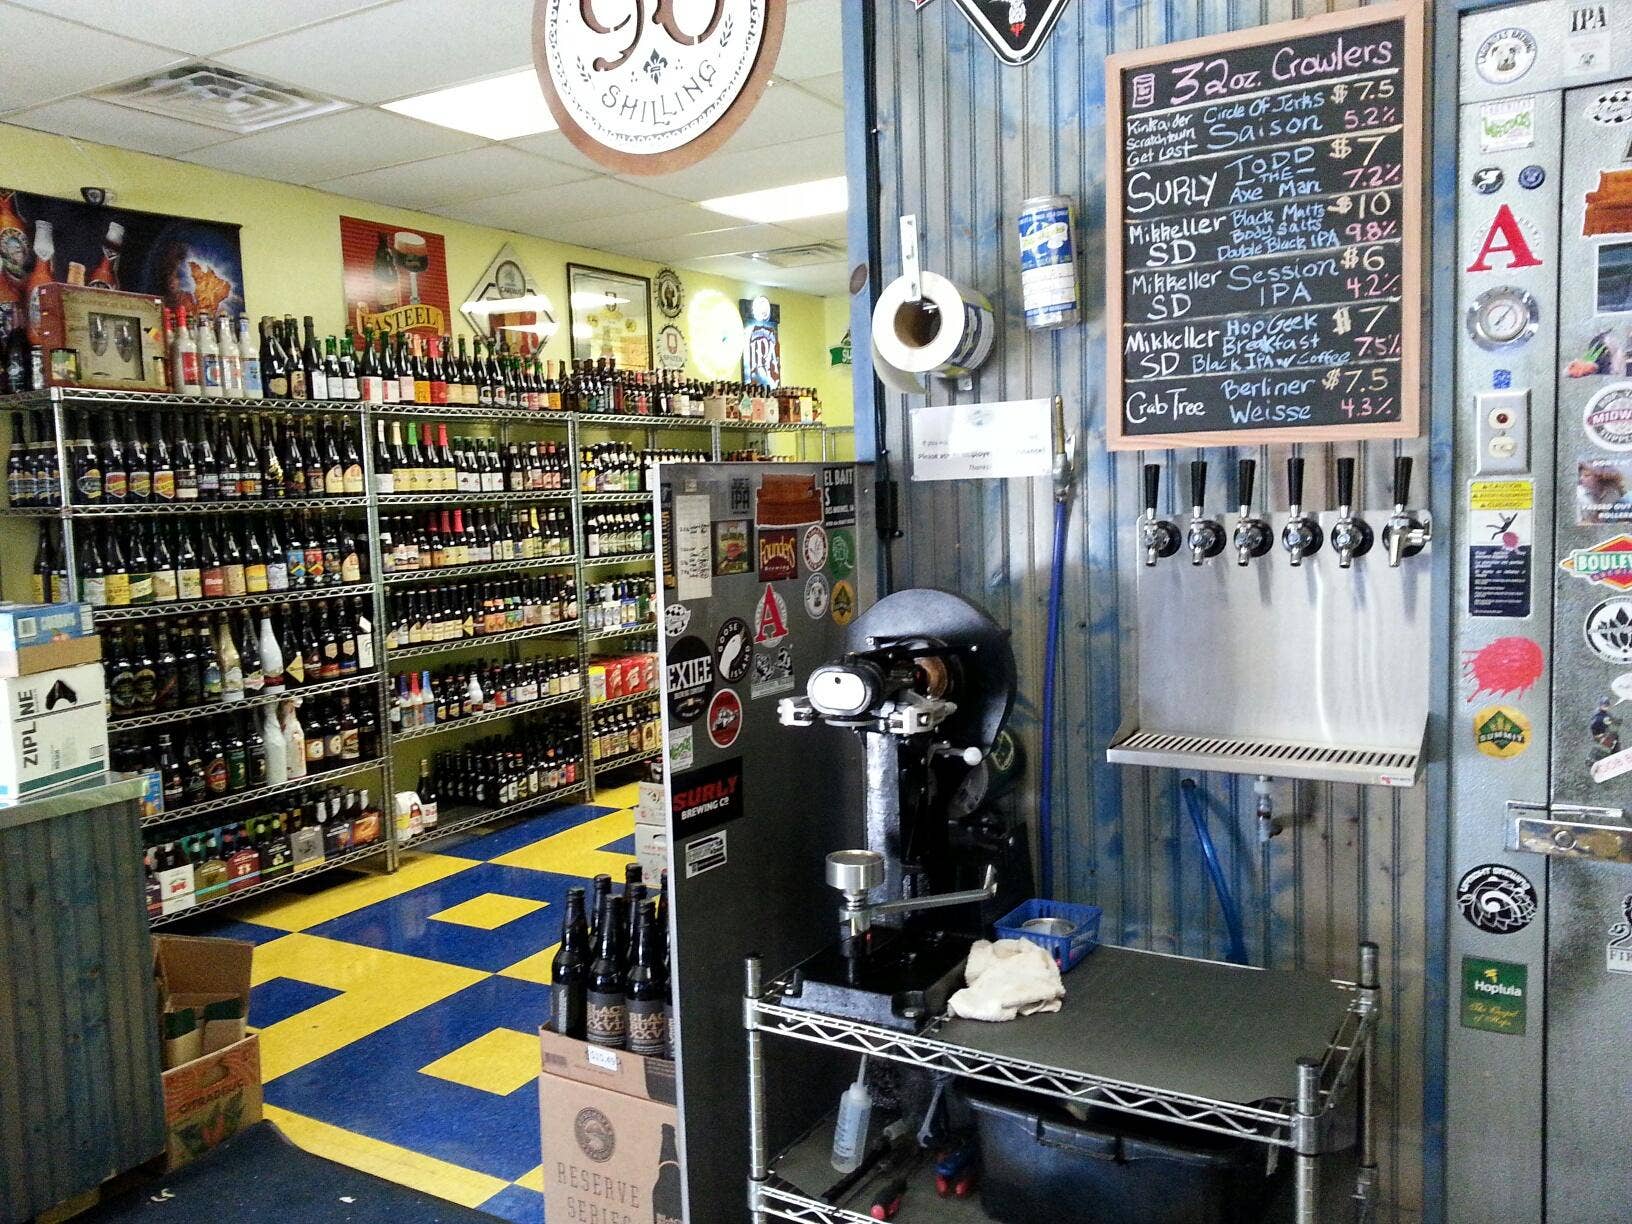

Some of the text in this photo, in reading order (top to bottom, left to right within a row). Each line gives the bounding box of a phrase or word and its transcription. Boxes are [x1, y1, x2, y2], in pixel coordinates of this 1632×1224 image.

[1571, 6, 1607, 32] IPA
[601, 58, 717, 126] SHILLING
[1203, 104, 1246, 123] Circle
[1270, 91, 1325, 112] Jerks
[1345, 106, 1396, 129] 5.2%
[1207, 115, 1323, 150] Saison
[1126, 140, 1199, 167] Get Lost
[1259, 166, 1294, 183] THE
[1342, 163, 1402, 189] 7.2%
[1126, 171, 1218, 213] SURLY
[1228, 179, 1323, 205] Axe Man
[1129, 216, 1227, 245] Mikkeller
[1230, 207, 1275, 229] Black
[1217, 241, 1264, 262] Double
[1310, 228, 1341, 250] IPA
[1229, 224, 1273, 245] Body
[1465, 203, 1543, 273] A
[1146, 239, 1197, 267] SD
[1131, 270, 1222, 296] Mikkeller
[1226, 257, 1340, 291] Session
[1346, 272, 1401, 299] 4.2%
[1147, 292, 1192, 320] SD
[1260, 280, 1312, 307] IPA
[361, 306, 437, 336] KASTEEL
[1226, 318, 1265, 340] Hop
[1123, 325, 1221, 356] Mikkeller
[1222, 332, 1321, 358] Breakfast
[1140, 352, 1181, 379] SD
[1191, 353, 1242, 373] Black
[1244, 351, 1275, 371] IPA
[1297, 349, 1350, 366] Coffee
[1220, 376, 1317, 401] Berliner
[1126, 387, 1207, 424] Crab Tree
[1229, 400, 1312, 424] Weisse
[1340, 397, 1394, 419] 4.3%
[824, 470, 833, 486] EL
[760, 535, 795, 569] Founders
[754, 582, 789, 644] A
[717, 622, 739, 653] GOOSE
[667, 655, 713, 694] EXILE
[1479, 731, 1525, 744] SUMMIT
[672, 775, 737, 813] SURLY
[681, 799, 718, 821] BREWING
[557, 1161, 640, 1210] RESERVE
